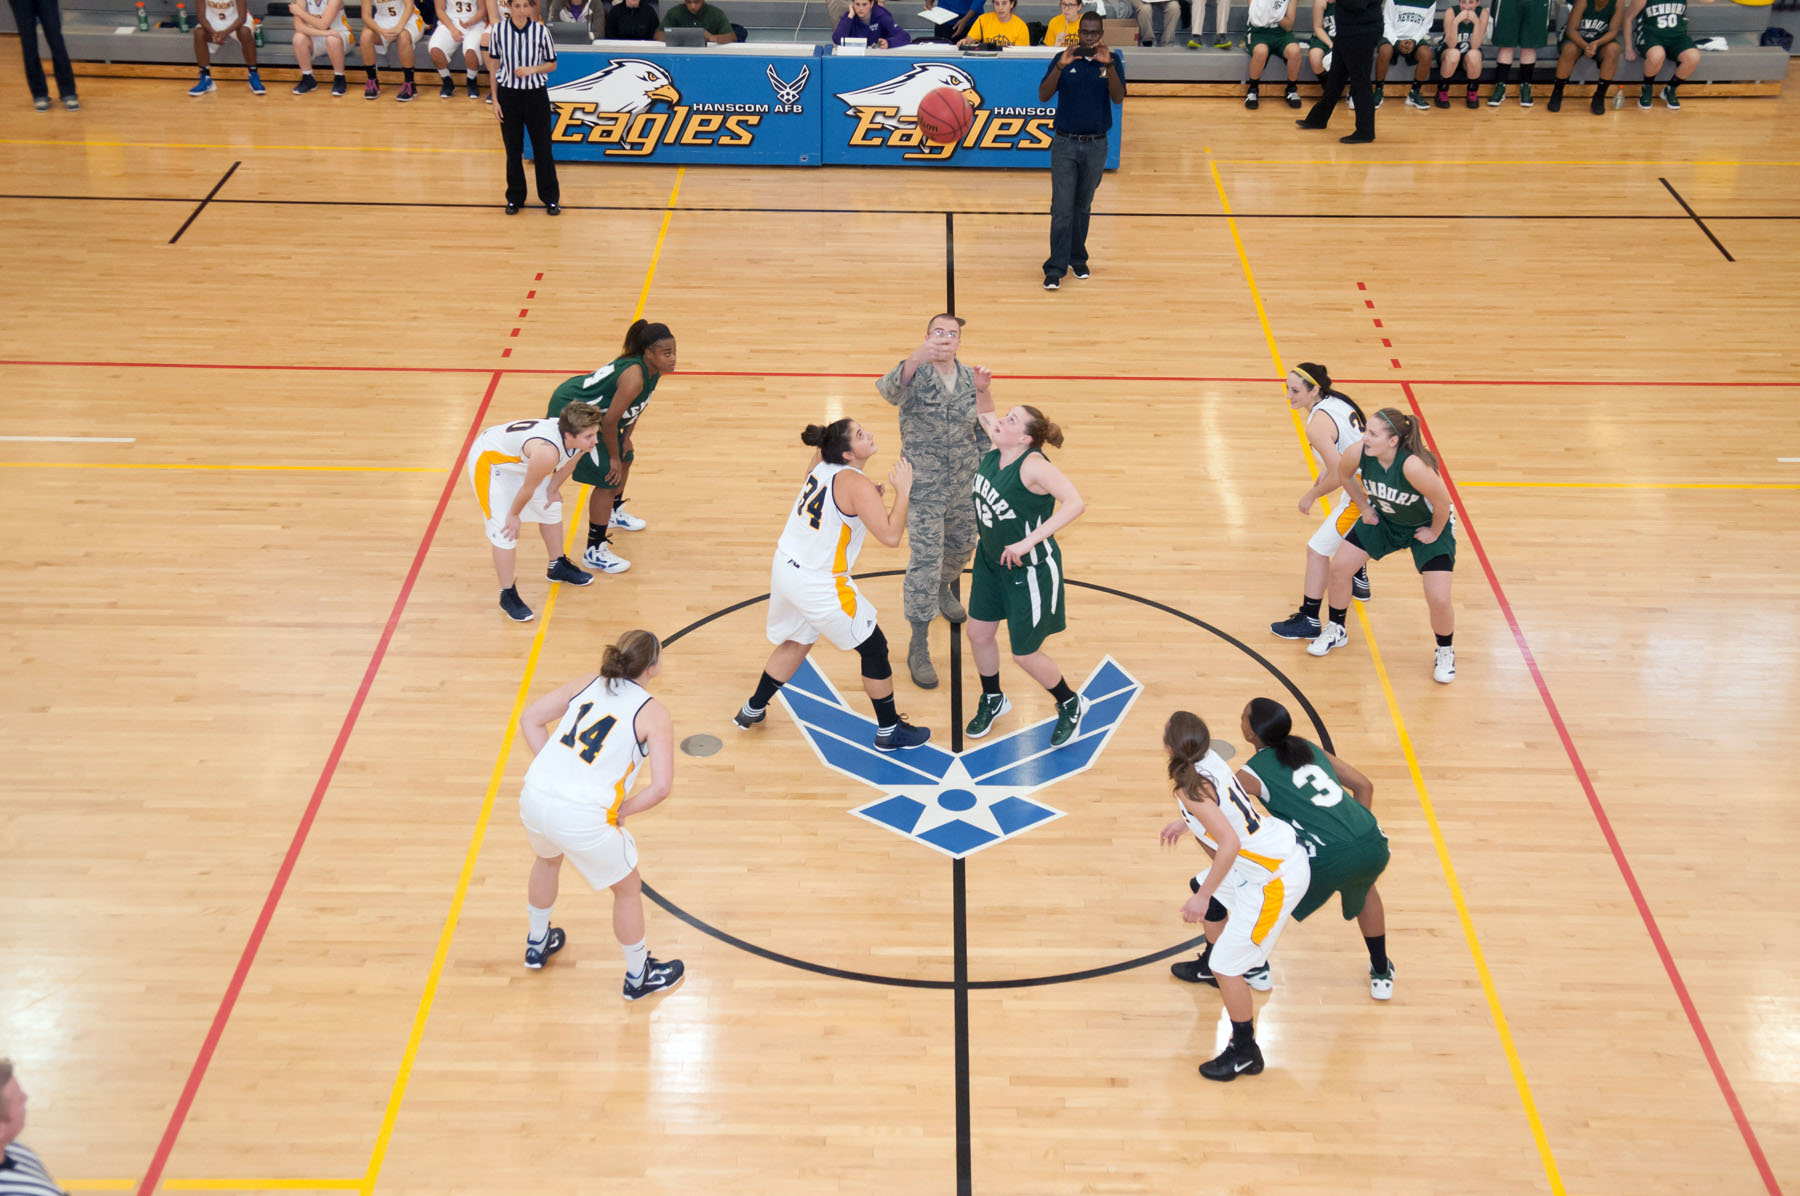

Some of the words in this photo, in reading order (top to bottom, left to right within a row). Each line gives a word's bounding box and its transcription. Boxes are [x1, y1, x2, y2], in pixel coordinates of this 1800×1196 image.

[387, 6, 397, 17] 5
[455, 1, 472, 13] 33
[1656, 14, 1678, 29] 50
[693, 103, 769, 113] HANSCOM
[774, 103, 803, 113] AFB
[994, 106, 1056, 116] HANSCO
[551, 101, 762, 157] Eagles
[796, 472, 823, 524] 34
[971, 472, 1017, 521] WBURY
[1362, 478, 1420, 507] EWBURY
[560, 701, 618, 765] 14
[1292, 764, 1344, 808] 3
[1227, 775, 1261, 837] 1
